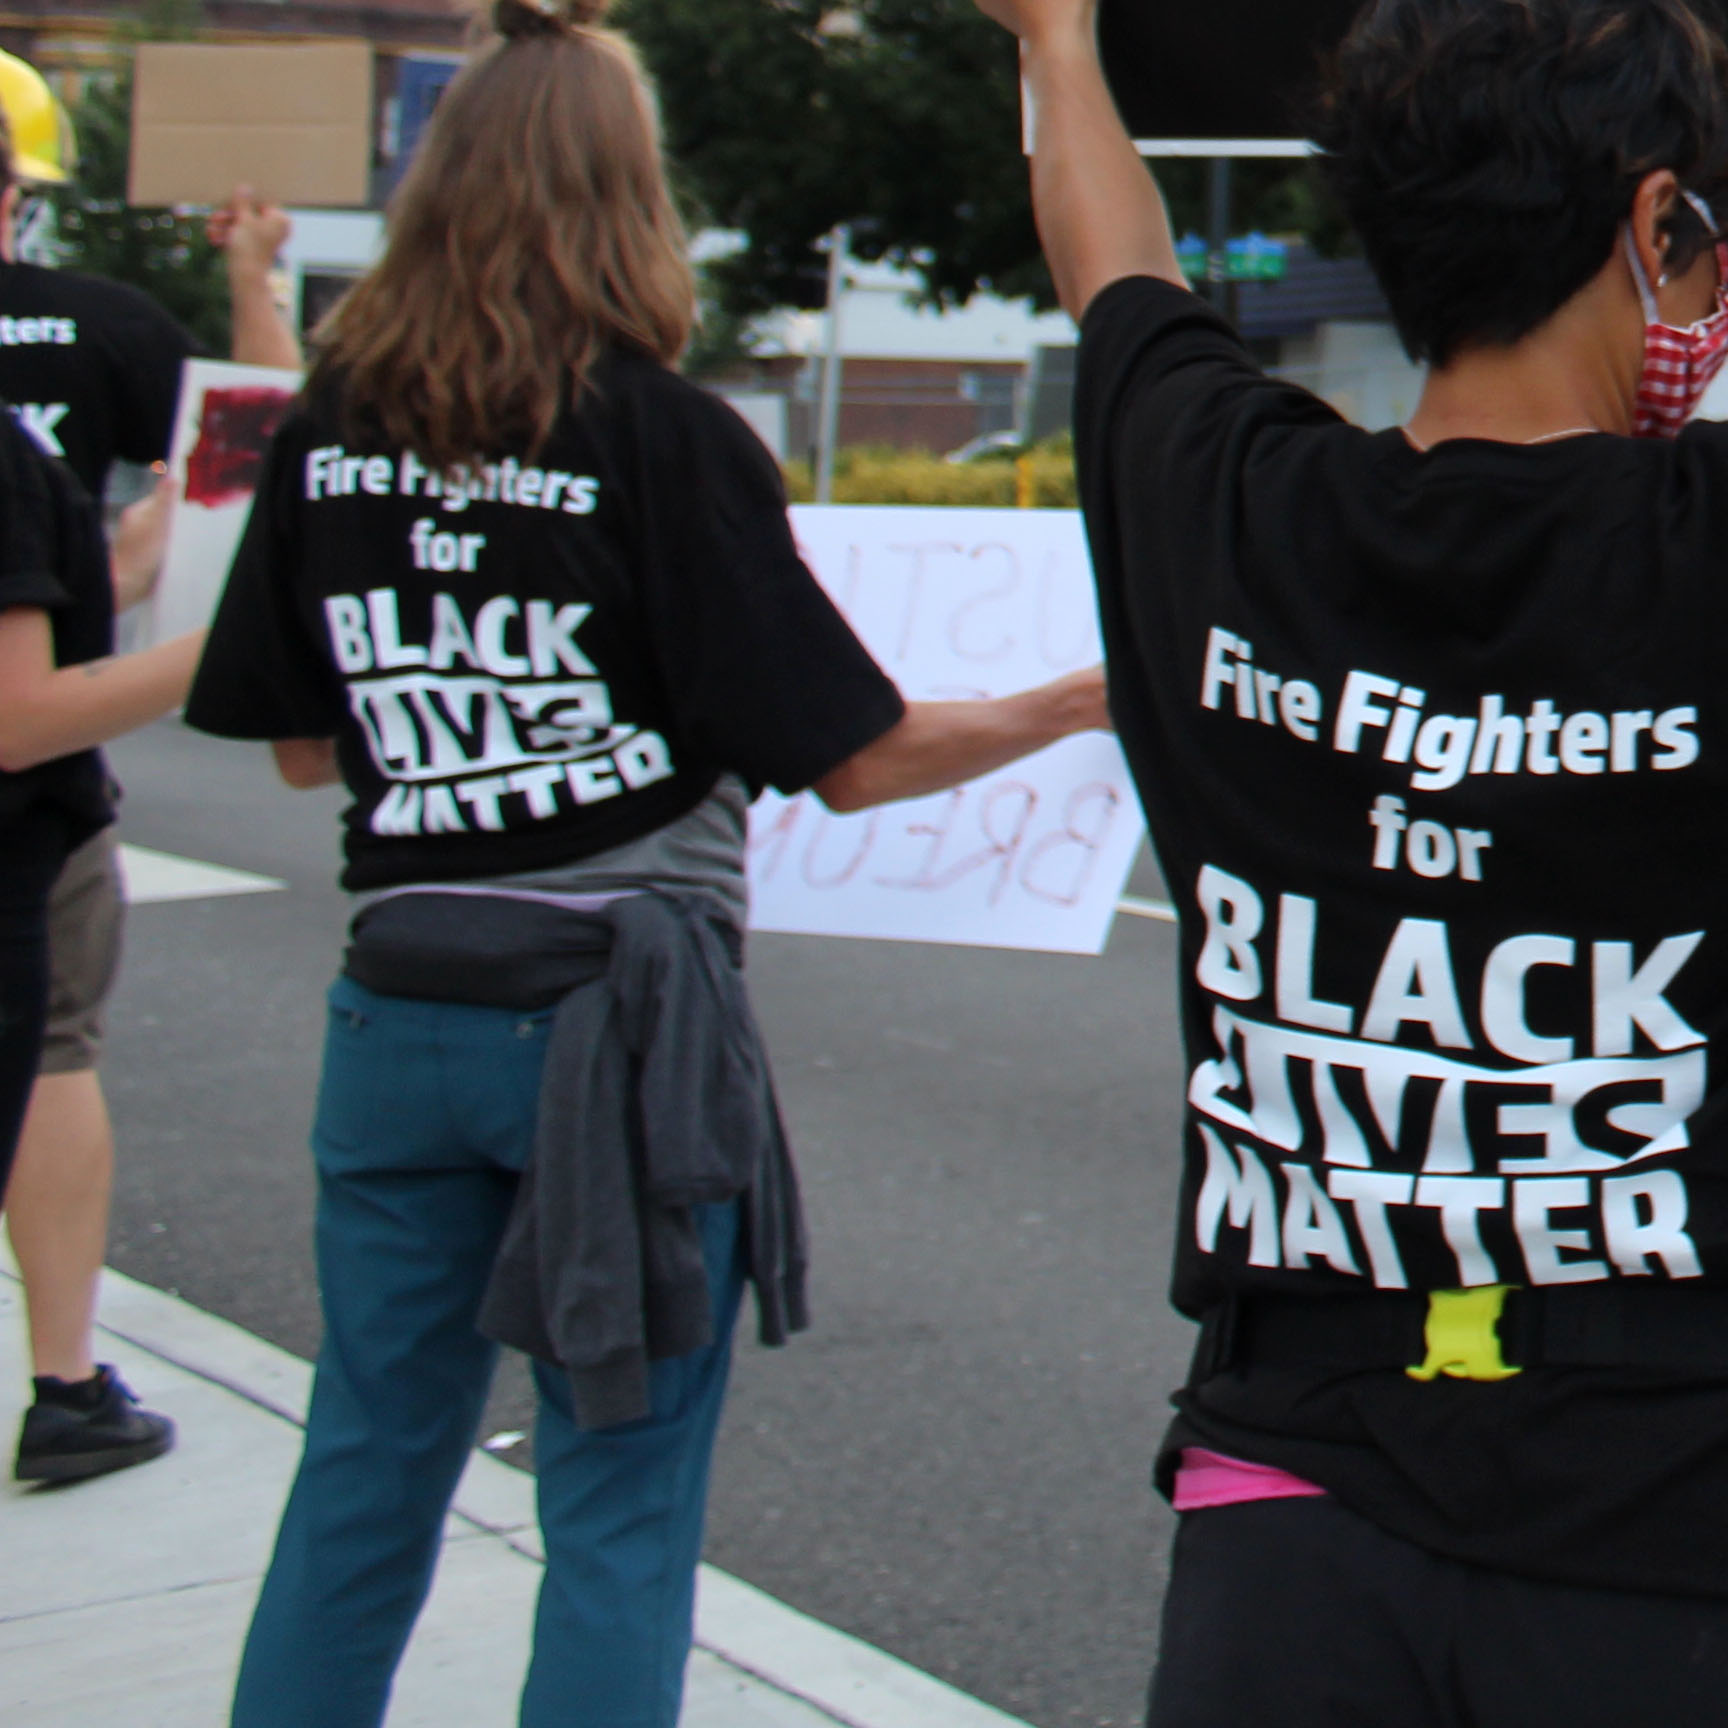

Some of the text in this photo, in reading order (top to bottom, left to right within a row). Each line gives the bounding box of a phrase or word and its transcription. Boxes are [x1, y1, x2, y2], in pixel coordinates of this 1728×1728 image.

[305, 444, 394, 501] Fire
[409, 517, 487, 572] for
[324, 587, 599, 677] BLACK
[1201, 626, 1701, 793] Fire Fighters
[1368, 792, 1492, 882] for
[1195, 863, 1709, 1066] BLACK
[1195, 1121, 1704, 1291] MATTER
